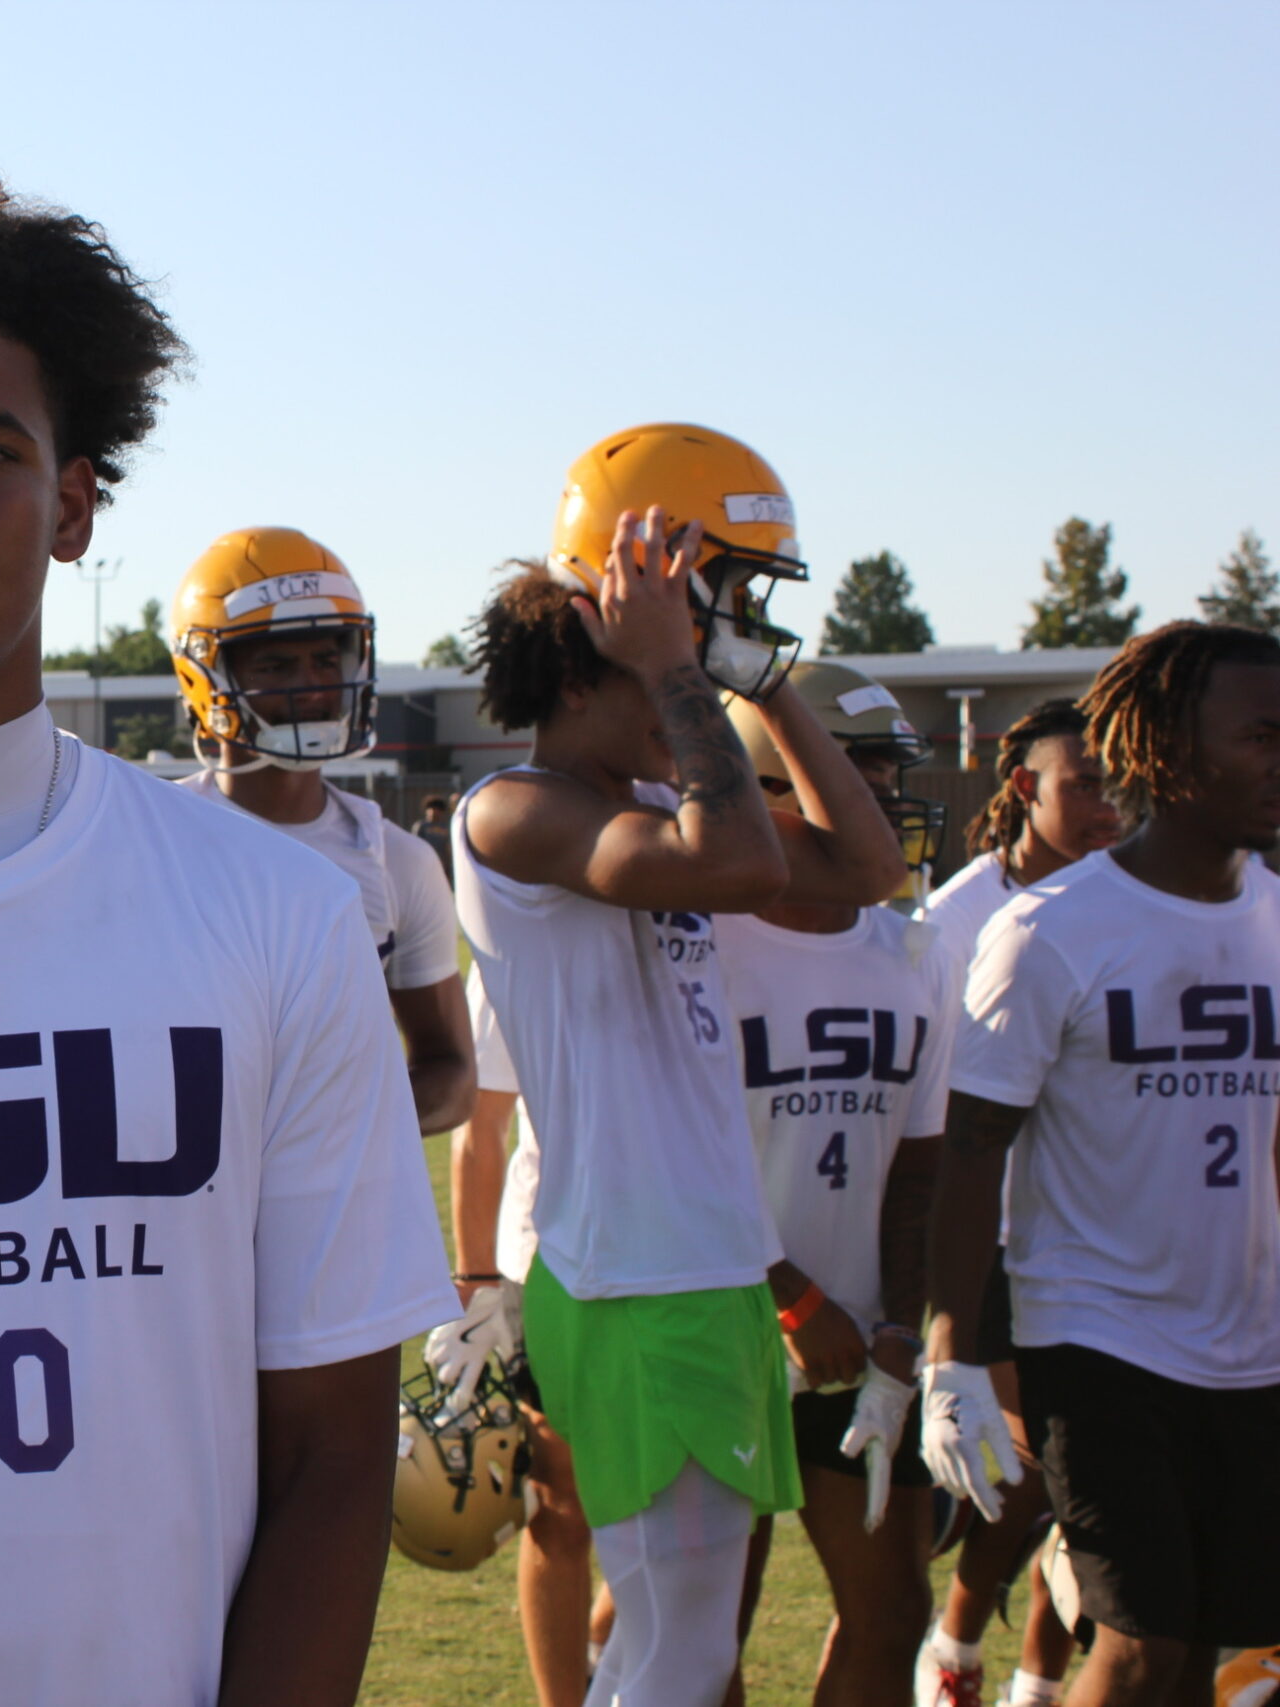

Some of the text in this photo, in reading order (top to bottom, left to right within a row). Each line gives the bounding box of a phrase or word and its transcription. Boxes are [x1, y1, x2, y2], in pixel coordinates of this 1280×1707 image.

[740, 1008, 928, 1089] LSU
[817, 1131, 849, 1190] 4
[1205, 1123, 1240, 1188] 2
